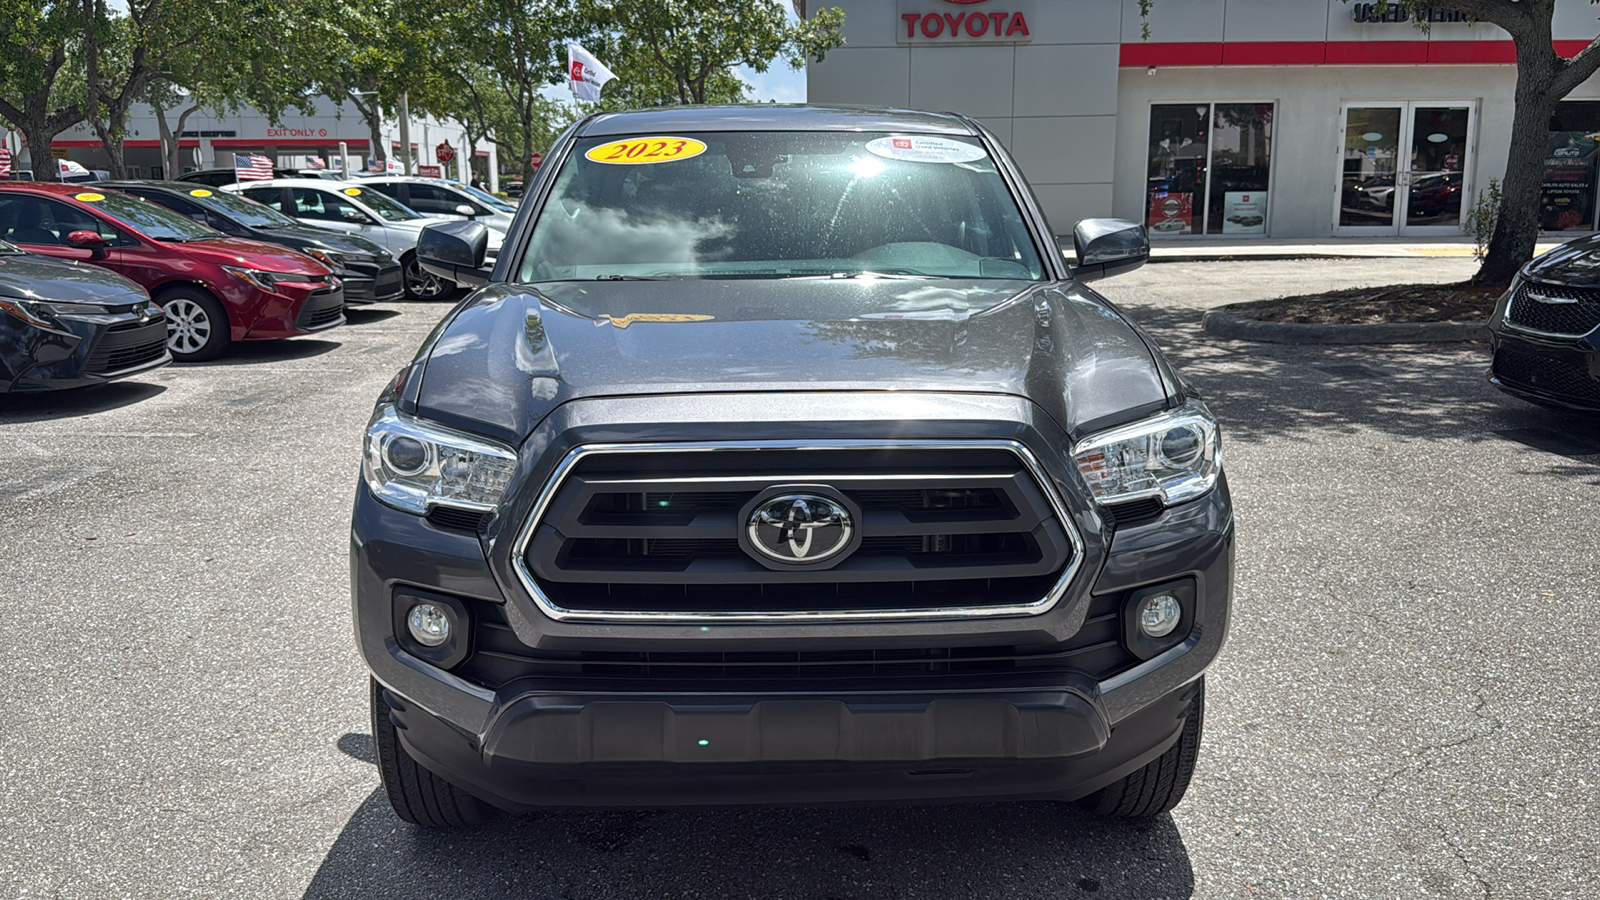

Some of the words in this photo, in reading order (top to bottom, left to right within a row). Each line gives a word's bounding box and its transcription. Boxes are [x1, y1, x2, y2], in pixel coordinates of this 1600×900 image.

[1354, 3, 1409, 23] USED
[901, 12, 1030, 38] TOYOTA
[267, 128, 287, 137] EXIT
[290, 128, 315, 137] ONLY
[604, 141, 687, 160] 2023
